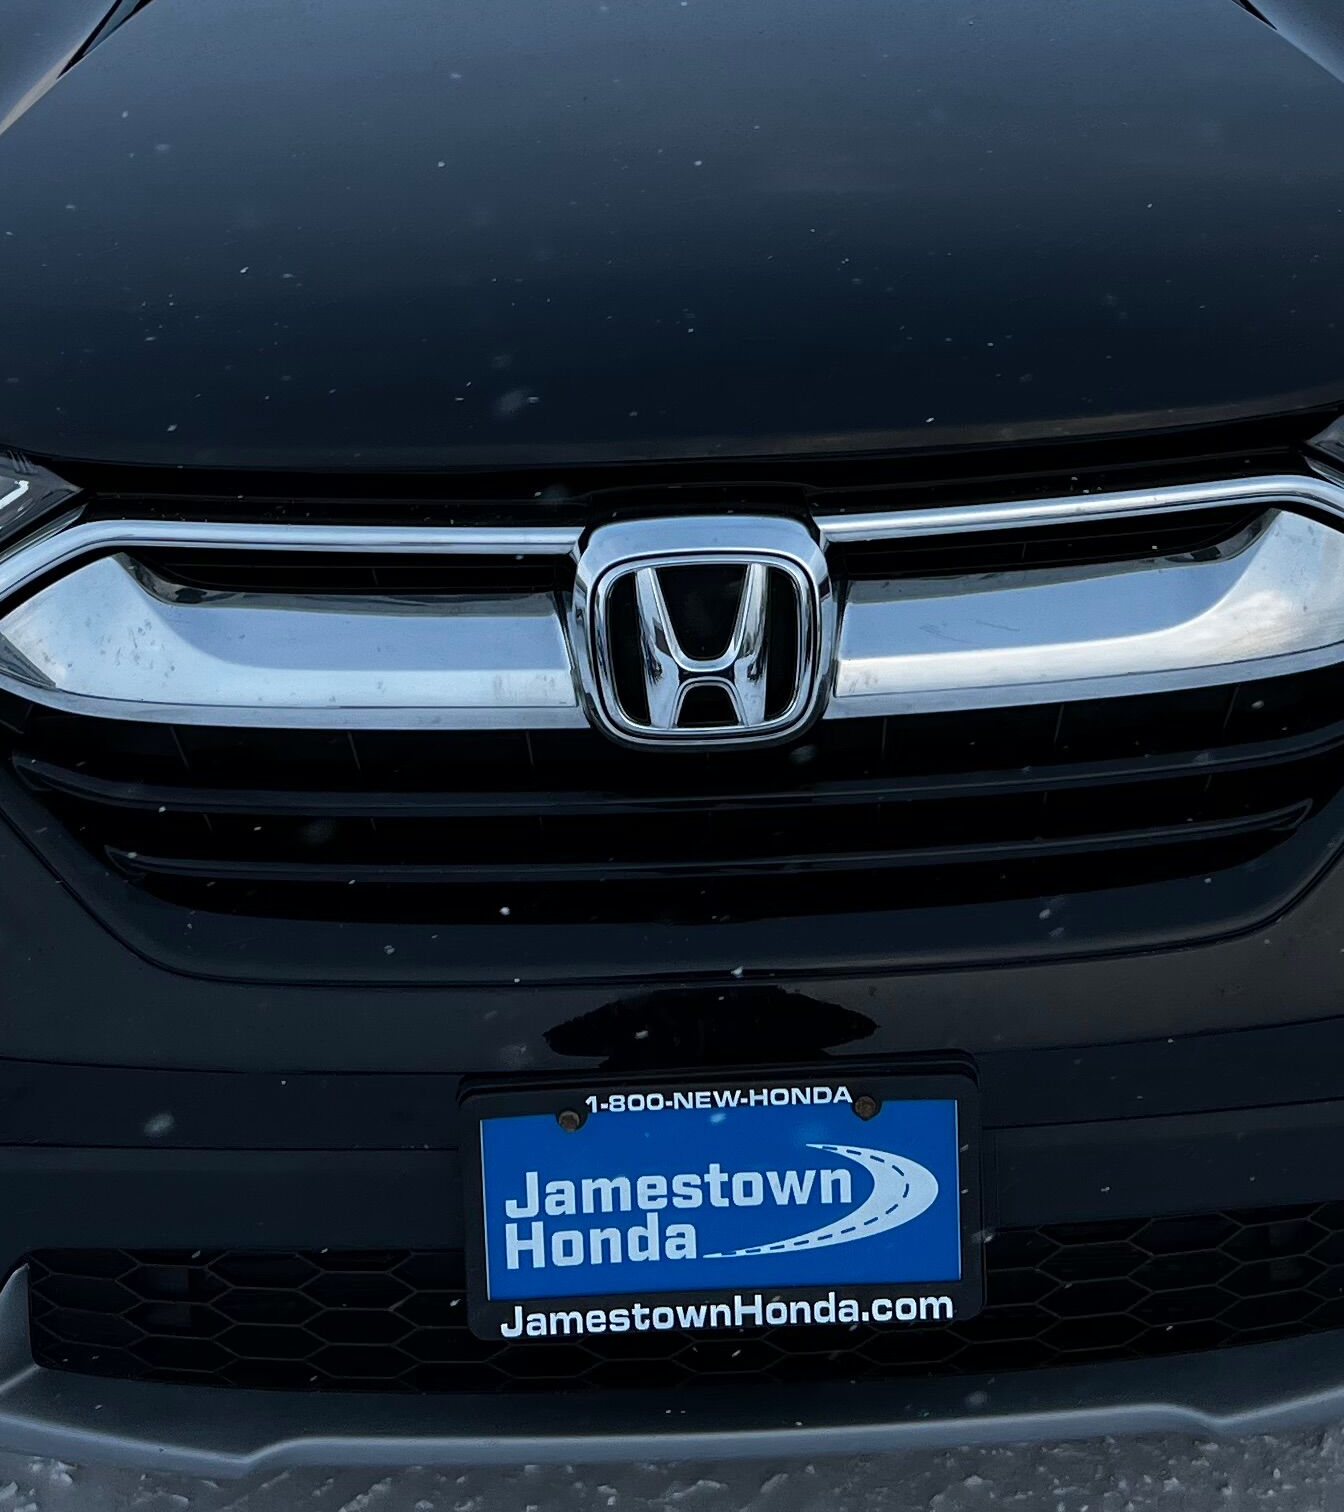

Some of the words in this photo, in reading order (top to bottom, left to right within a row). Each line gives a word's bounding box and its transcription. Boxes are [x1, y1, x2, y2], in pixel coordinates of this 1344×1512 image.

[585, 1086, 853, 1113] 1-800-NEW-HONDA
[505, 1163, 852, 1219] Jamestown
[505, 1211, 698, 1270] Honda
[500, 1291, 953, 1338] JamestownHonda.com
